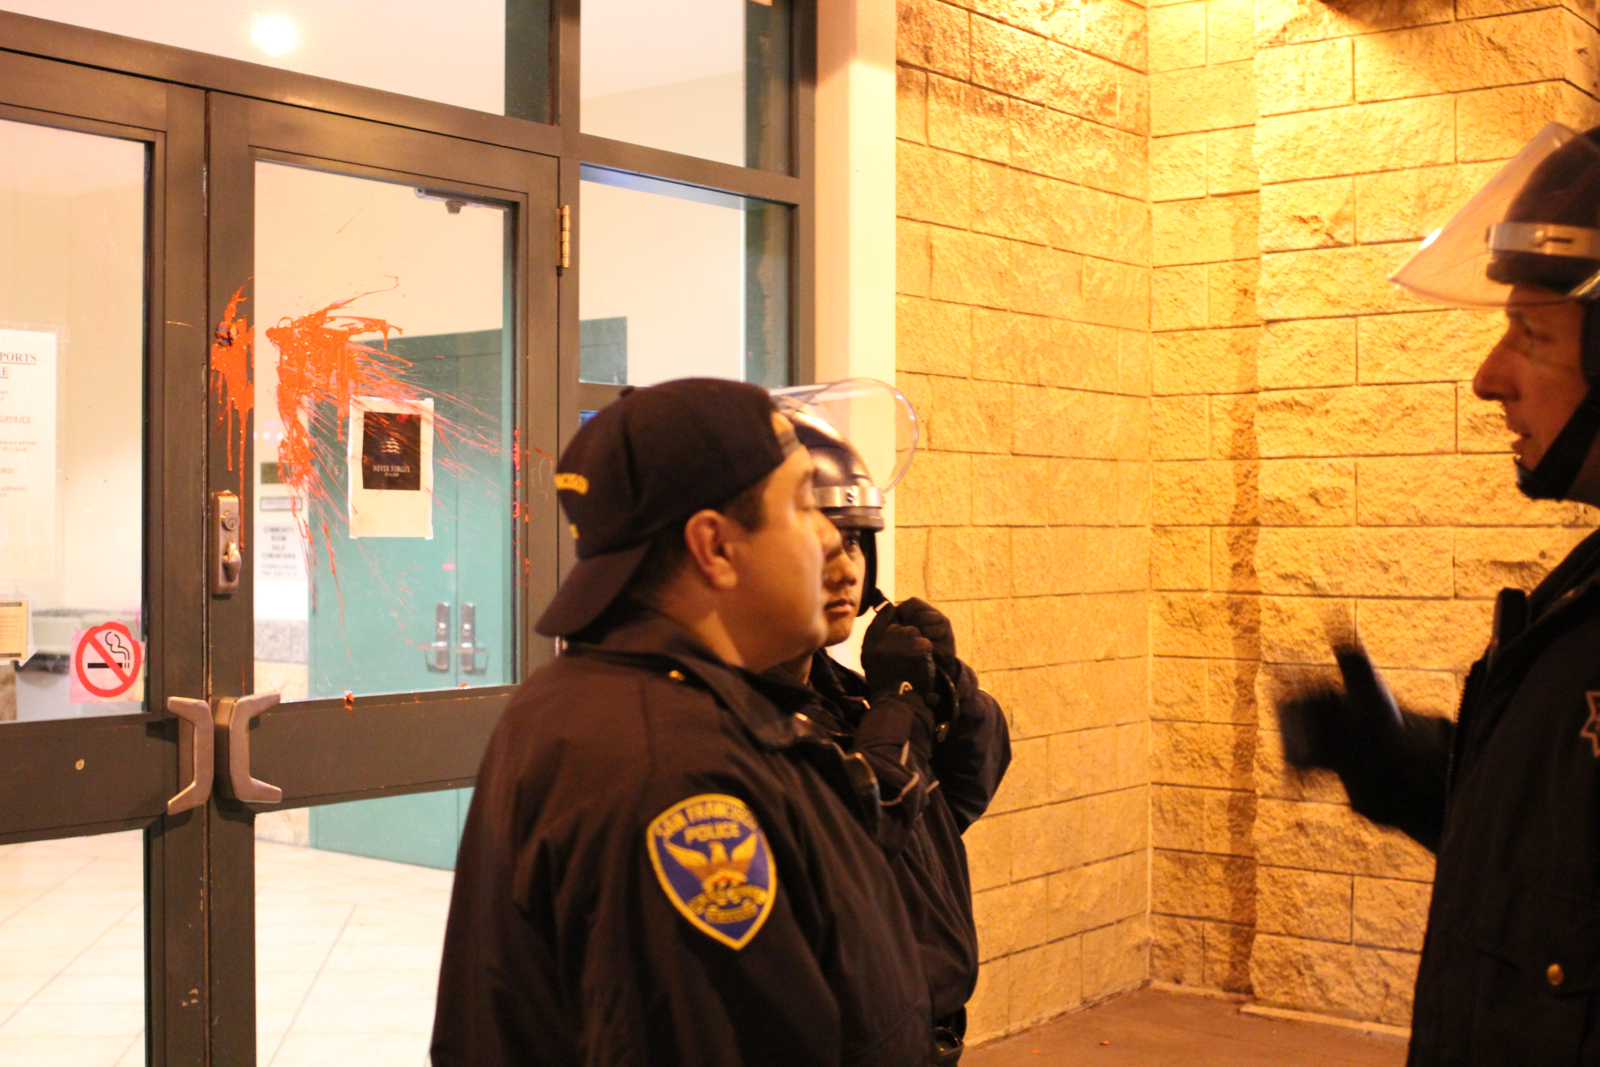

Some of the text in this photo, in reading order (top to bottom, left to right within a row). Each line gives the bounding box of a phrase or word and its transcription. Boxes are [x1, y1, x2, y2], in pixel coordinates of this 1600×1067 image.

[0, 351, 37, 363] PORTS
[654, 809, 688, 837] SAN
[684, 821, 740, 844] POLICE
